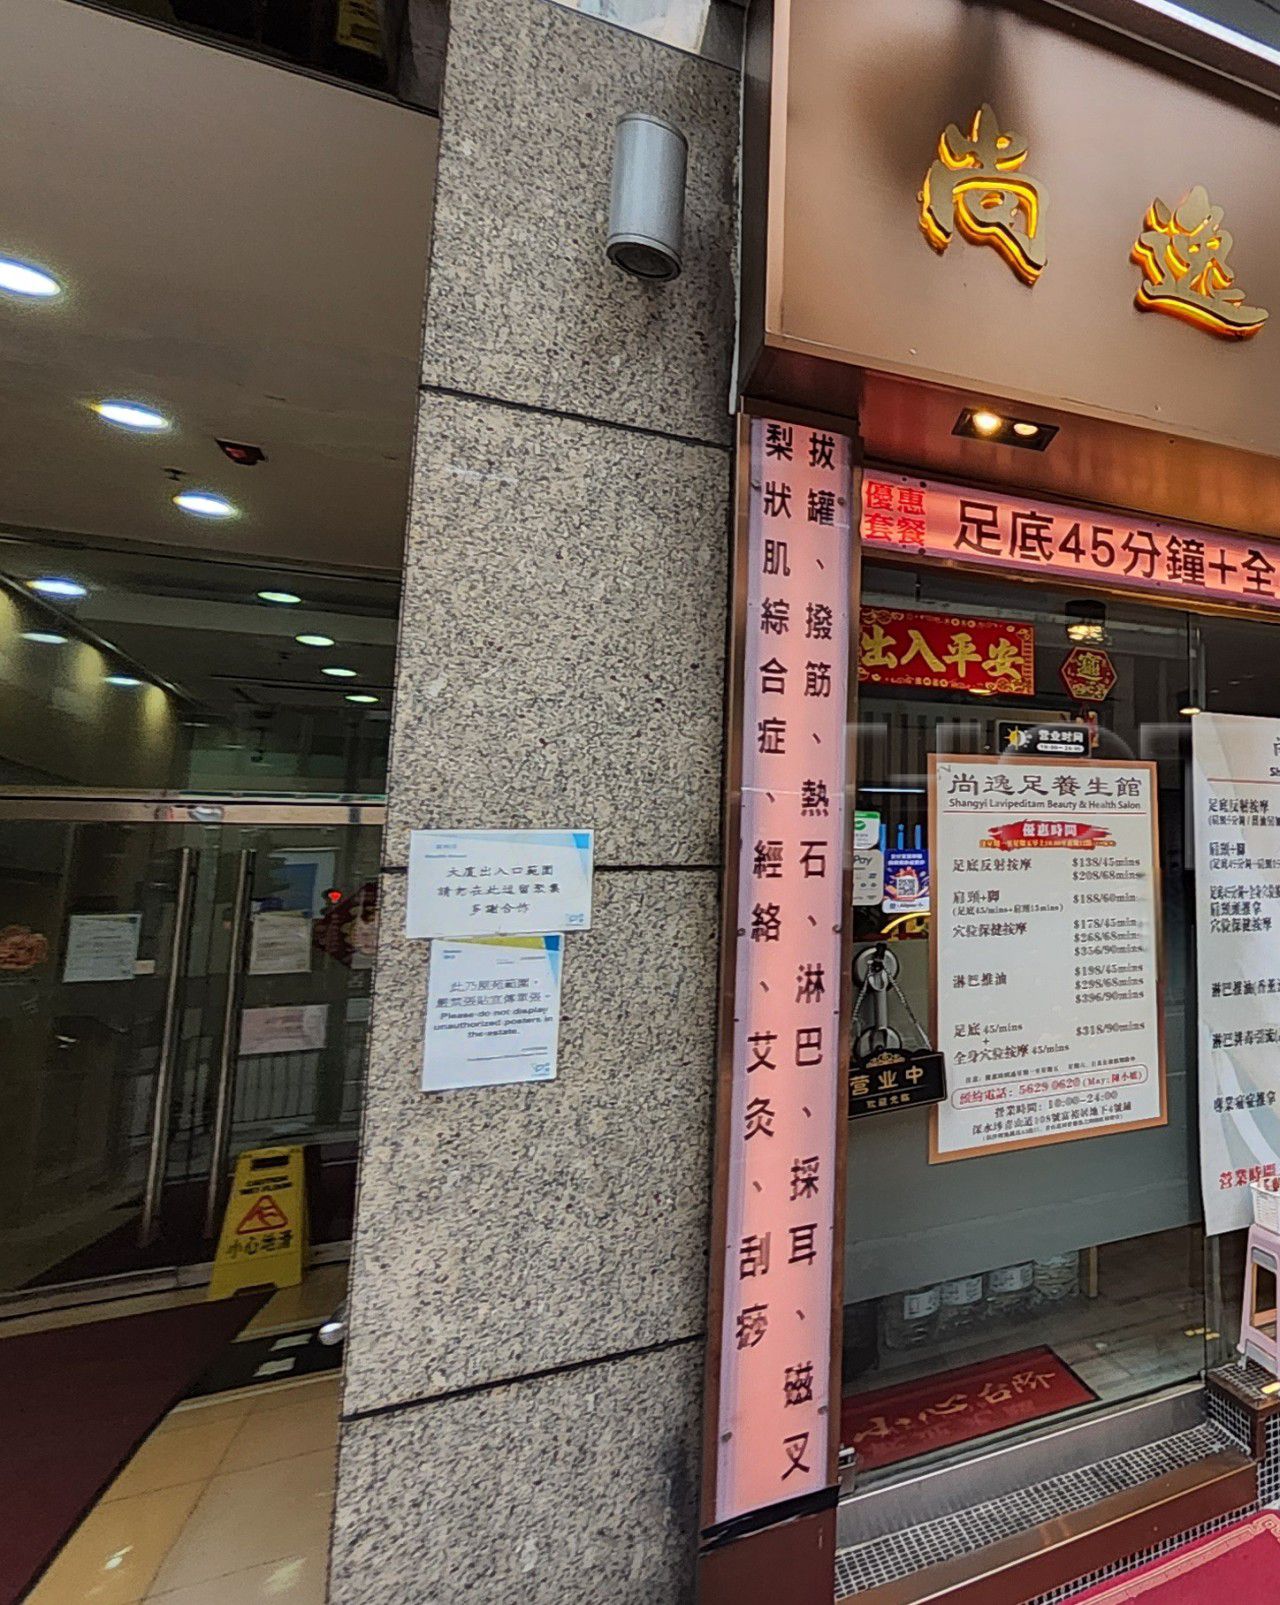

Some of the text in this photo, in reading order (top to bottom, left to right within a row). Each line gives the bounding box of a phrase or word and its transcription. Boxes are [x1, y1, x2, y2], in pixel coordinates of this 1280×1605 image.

[865, 480, 926, 516] 優惠
[864, 513, 926, 546] 套餐
[860, 624, 1025, 680] 出入平安
[947, 772, 1142, 798] 尚逸足養生館
[949, 798, 988, 811] Shangyi
[1048, 800, 1077, 811] Beauty
[1079, 801, 1086, 809] &
[1088, 800, 1117, 809] Health
[1118, 800, 1141, 810] Salon
[849, 1065, 924, 1096] 营业中
